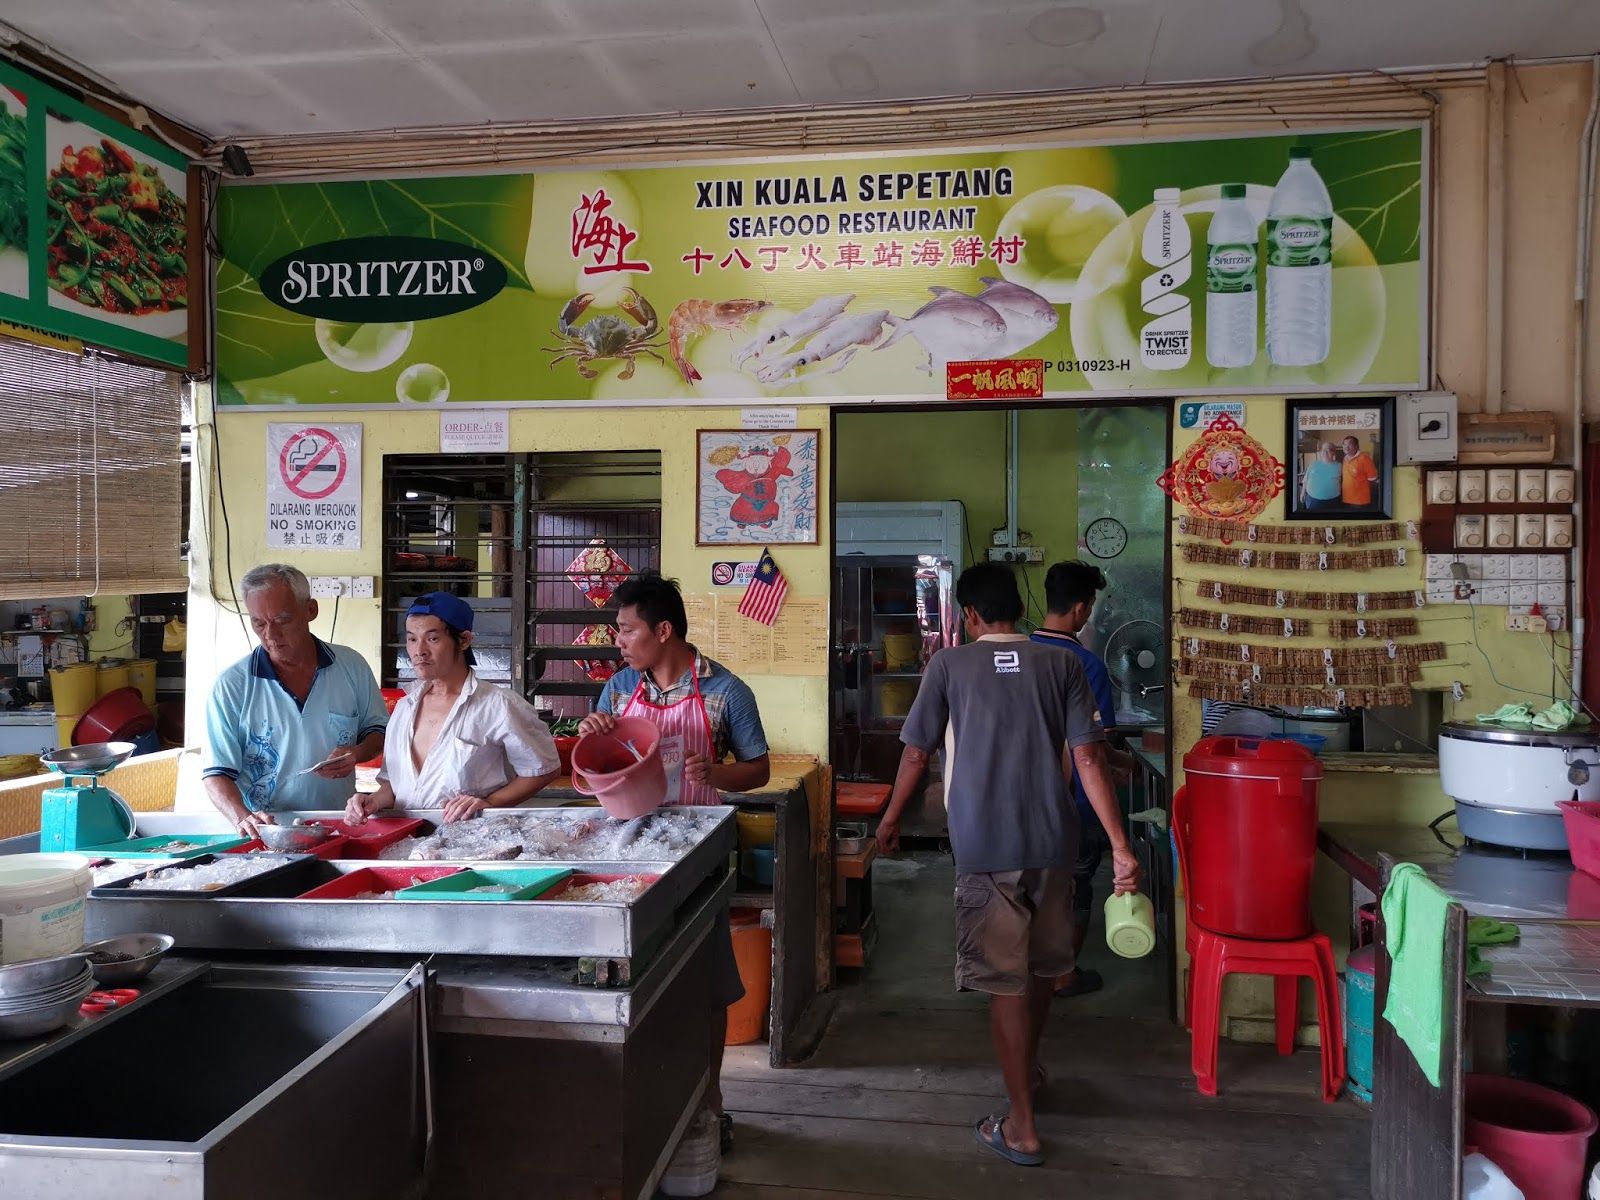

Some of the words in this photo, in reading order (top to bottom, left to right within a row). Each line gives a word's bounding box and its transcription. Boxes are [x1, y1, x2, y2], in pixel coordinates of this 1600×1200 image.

[696, 181, 742, 208] XIN
[755, 176, 847, 206] KUALA
[858, 167, 1012, 201] SEPETANG
[728, 214, 830, 239] SEAFOOD
[839, 207, 976, 234] RESTAURANT
[682, 235, 1025, 274] 十八丁火車站海鮮村
[1145, 337, 1189, 348] TWIST
[1057, 359, 1130, 372] 0310923-H
[270, 503, 311, 516] DILARANG
[314, 503, 357, 517] MEROKOK
[270, 519, 289, 530] NO
[295, 519, 356, 531] SMOKING
